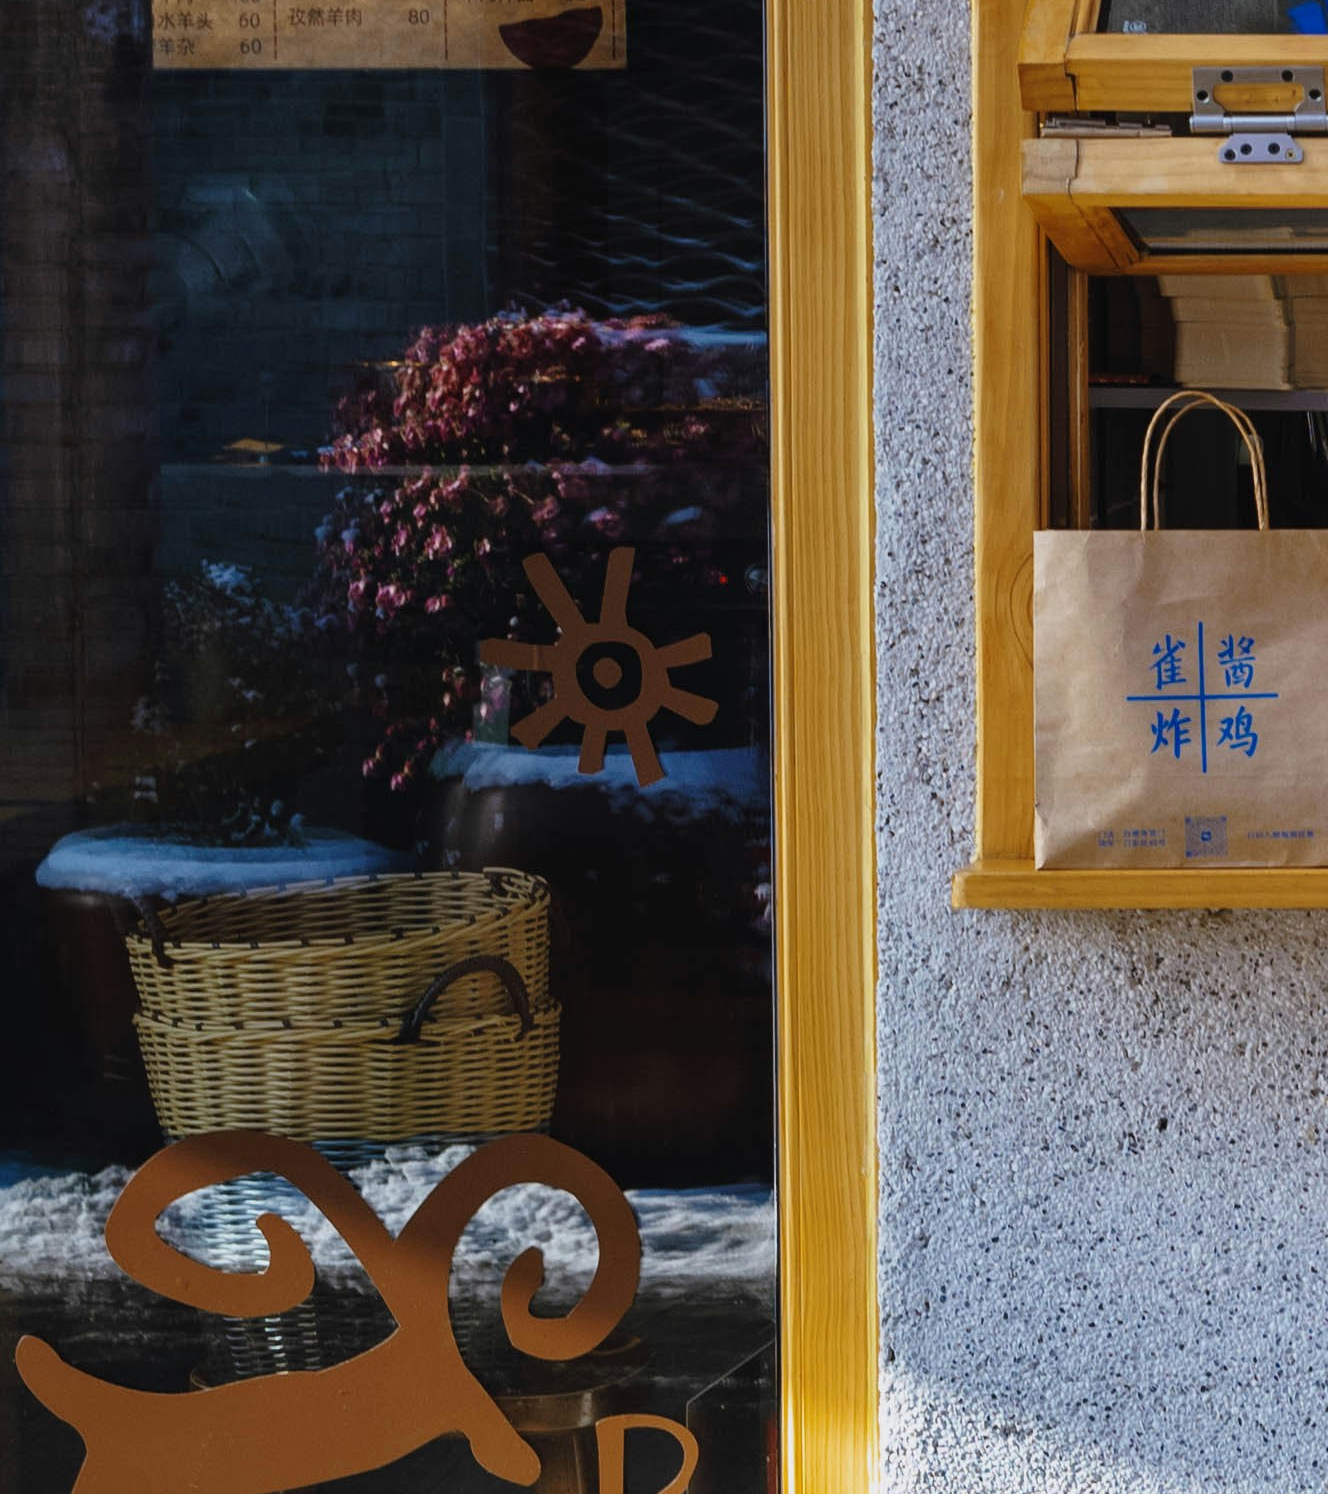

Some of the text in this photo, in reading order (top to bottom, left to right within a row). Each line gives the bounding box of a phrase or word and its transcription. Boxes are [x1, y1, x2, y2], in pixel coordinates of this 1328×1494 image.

[239, 12, 260, 28] 60
[408, 9, 430, 25] 80
[240, 38, 262, 54] 60
